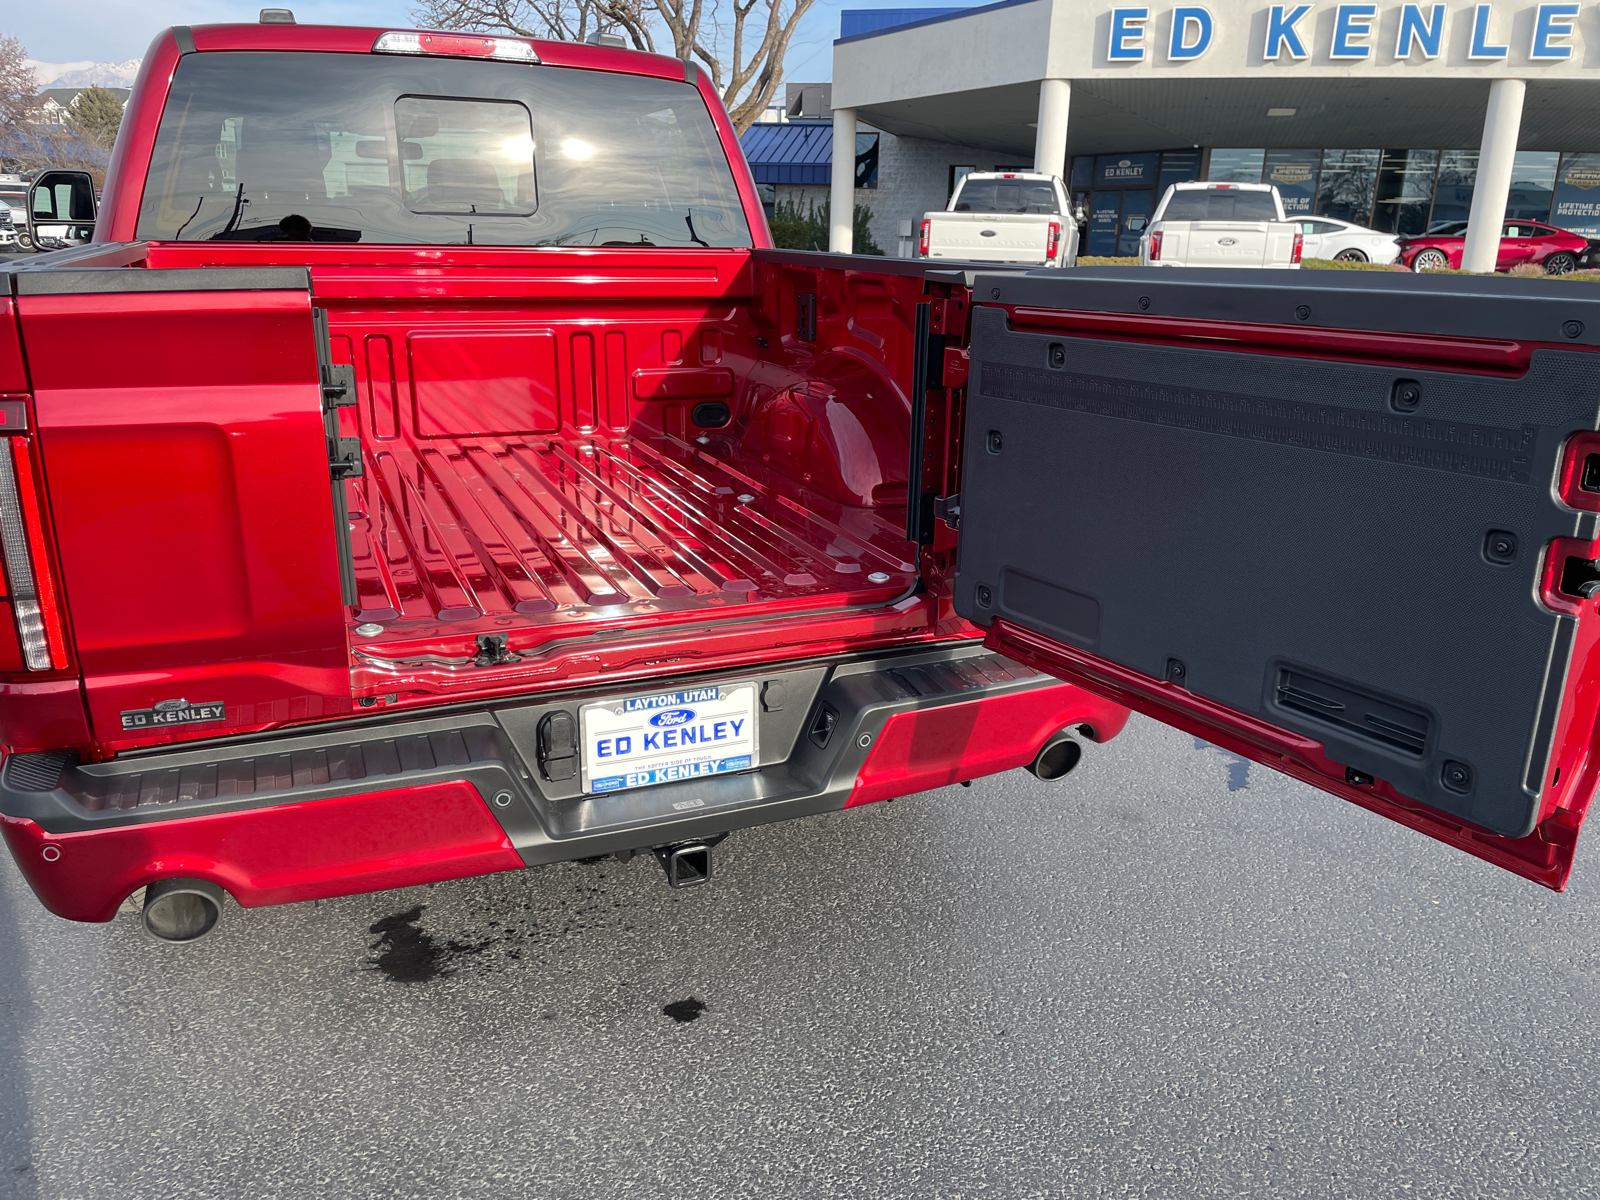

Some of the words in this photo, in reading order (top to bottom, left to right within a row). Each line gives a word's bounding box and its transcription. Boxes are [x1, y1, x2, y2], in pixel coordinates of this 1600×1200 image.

[1107, 6, 1216, 62] ED
[1263, 3, 1582, 60] KENLE
[1105, 169, 1114, 177] ED
[1116, 167, 1143, 176] KENLEY
[1557, 208, 1600, 216] PROTECTIO
[626, 695, 681, 711] LAYTON,
[684, 689, 717, 703] UTAH
[122, 715, 146, 726] ED
[153, 707, 223, 723] KENLEY
[658, 711, 687, 726] Ford
[597, 736, 631, 758] ED
[644, 719, 745, 751] KENLEY
[626, 773, 650, 787] ED
[656, 761, 720, 782] KENLEY
